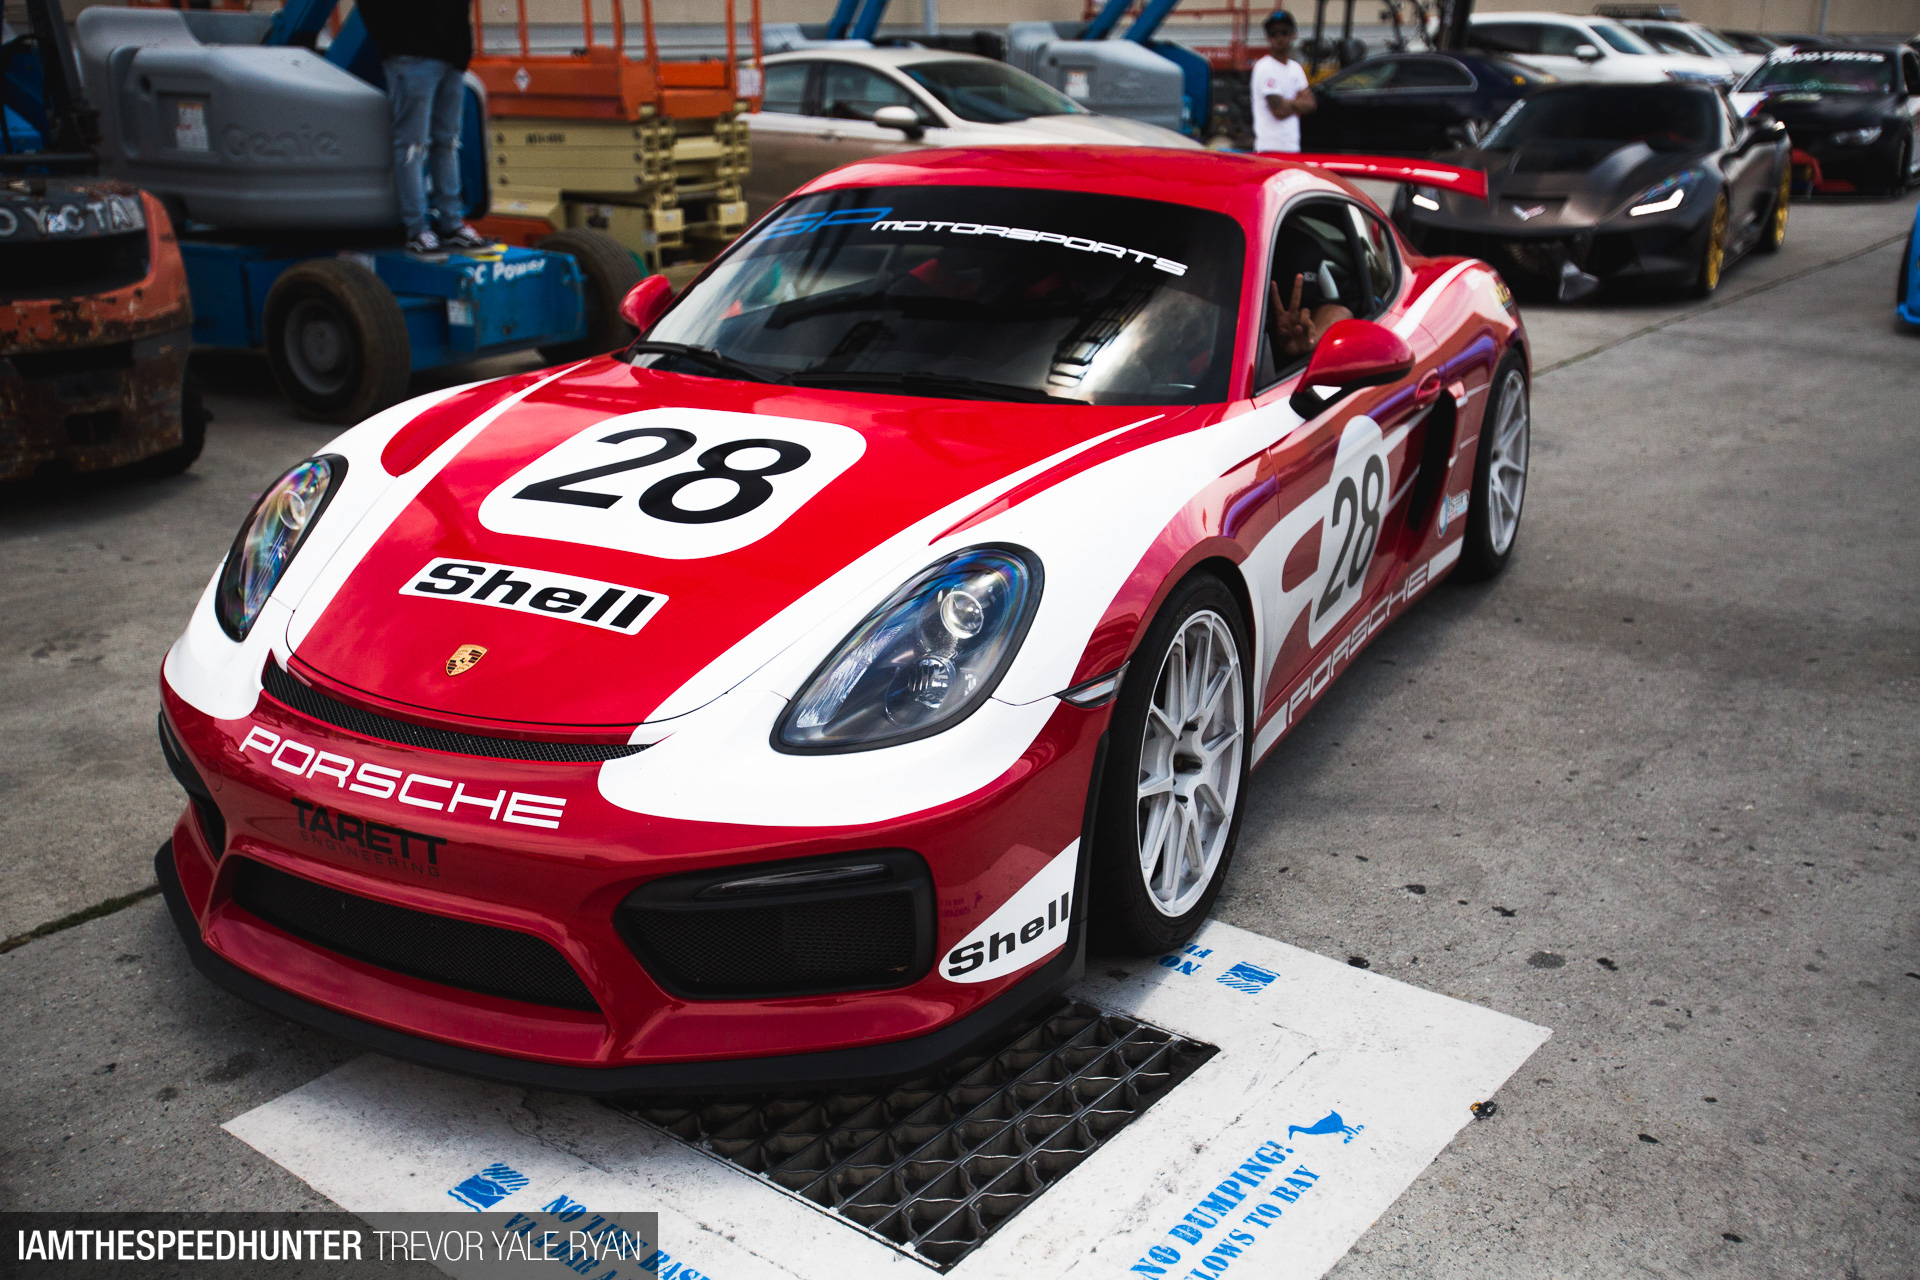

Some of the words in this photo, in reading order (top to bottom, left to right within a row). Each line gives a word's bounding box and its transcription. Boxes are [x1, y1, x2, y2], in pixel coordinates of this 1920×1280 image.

[870, 220, 1188, 276] MOTORSPORTS
[511, 427, 812, 524] 28
[1314, 454, 1384, 623] 28
[414, 563, 655, 629] Shell
[1288, 562, 1429, 724] PORSCHE
[239, 725, 567, 829] PORSCHE
[291, 797, 447, 865] TARETT
[301, 831, 440, 878] ENGINEERING
[948, 892, 1069, 977] Shell
[1158, 955, 1202, 976] NO
[542, 1194, 587, 1223] NO
[1130, 1245, 1181, 1280] NO
[1168, 1140, 1294, 1246] DUMPING!
[1183, 1228, 1255, 1280] LOWS
[1243, 1203, 1282, 1229] TO
[1270, 1165, 1320, 1204] BAY
